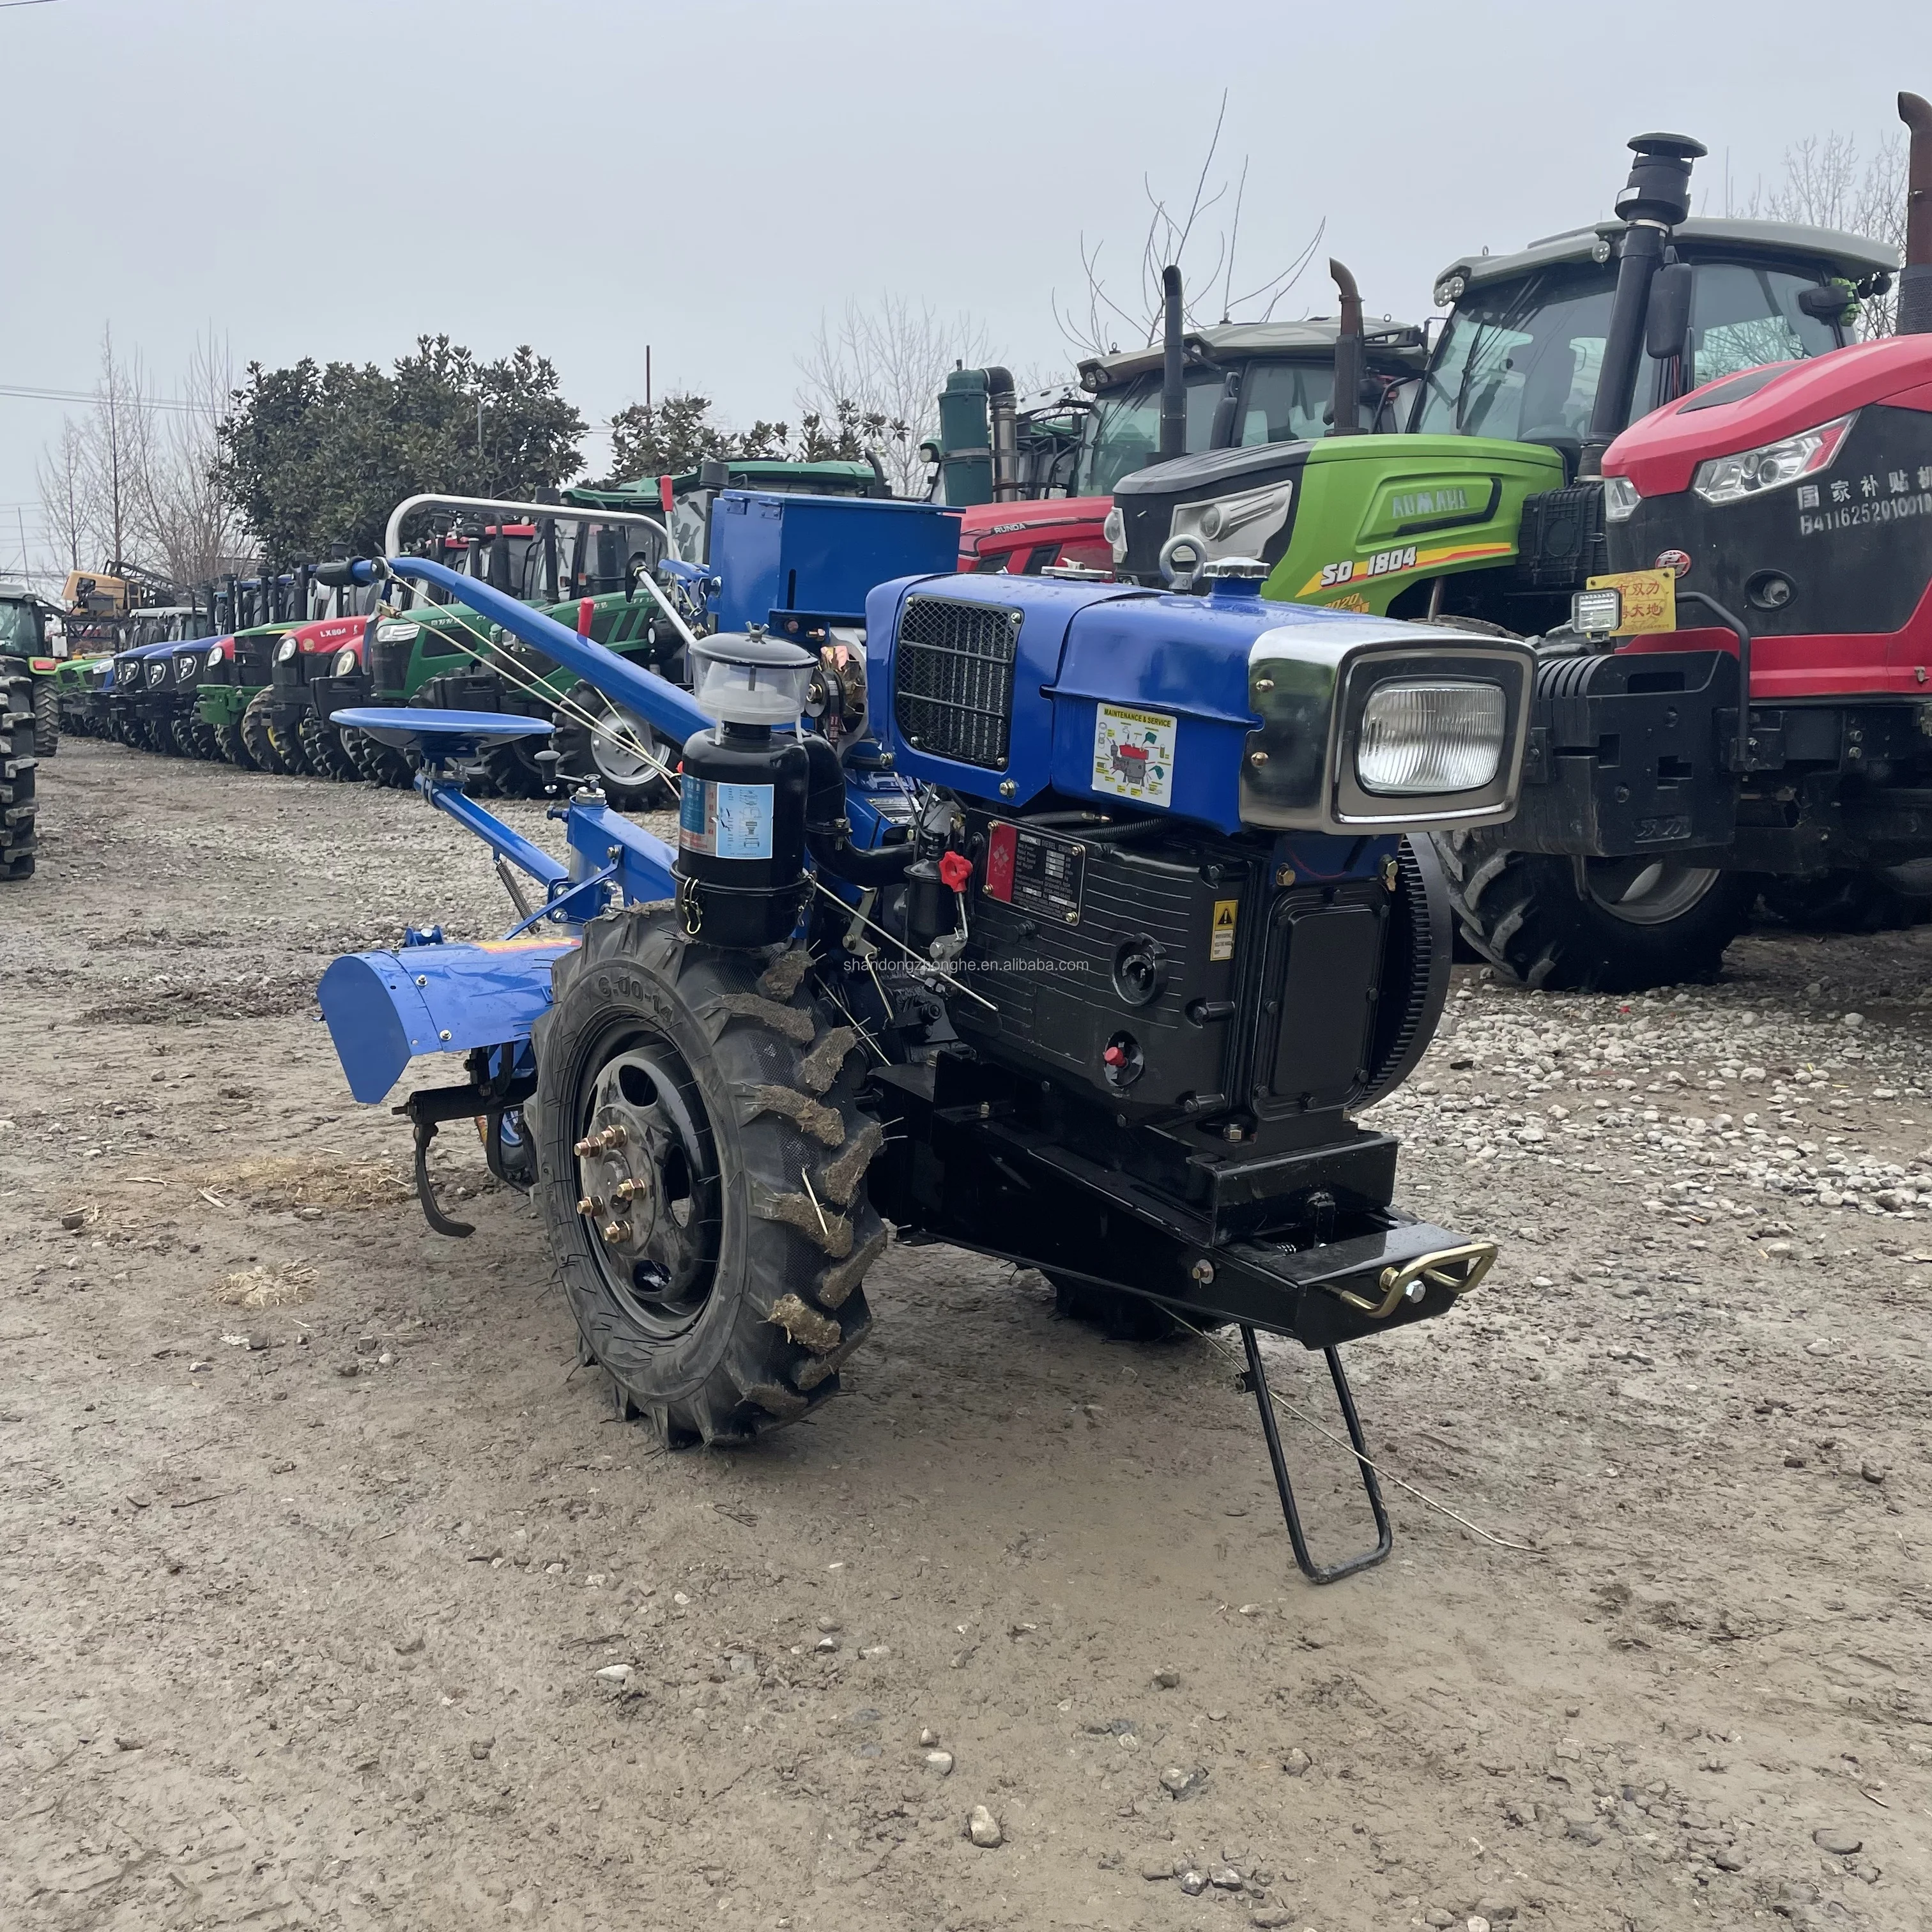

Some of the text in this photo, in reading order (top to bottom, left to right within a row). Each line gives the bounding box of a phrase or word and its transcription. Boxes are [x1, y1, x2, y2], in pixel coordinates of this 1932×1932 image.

[993, 523, 1026, 534] RUNDA
[1367, 546, 1417, 576] 1804
[319, 627, 346, 638] LX804
[1104, 708, 1142, 723] MAINTENANCE
[1147, 717, 1171, 728] SERVICE
[598, 976, 673, 1027] 6.00-14
